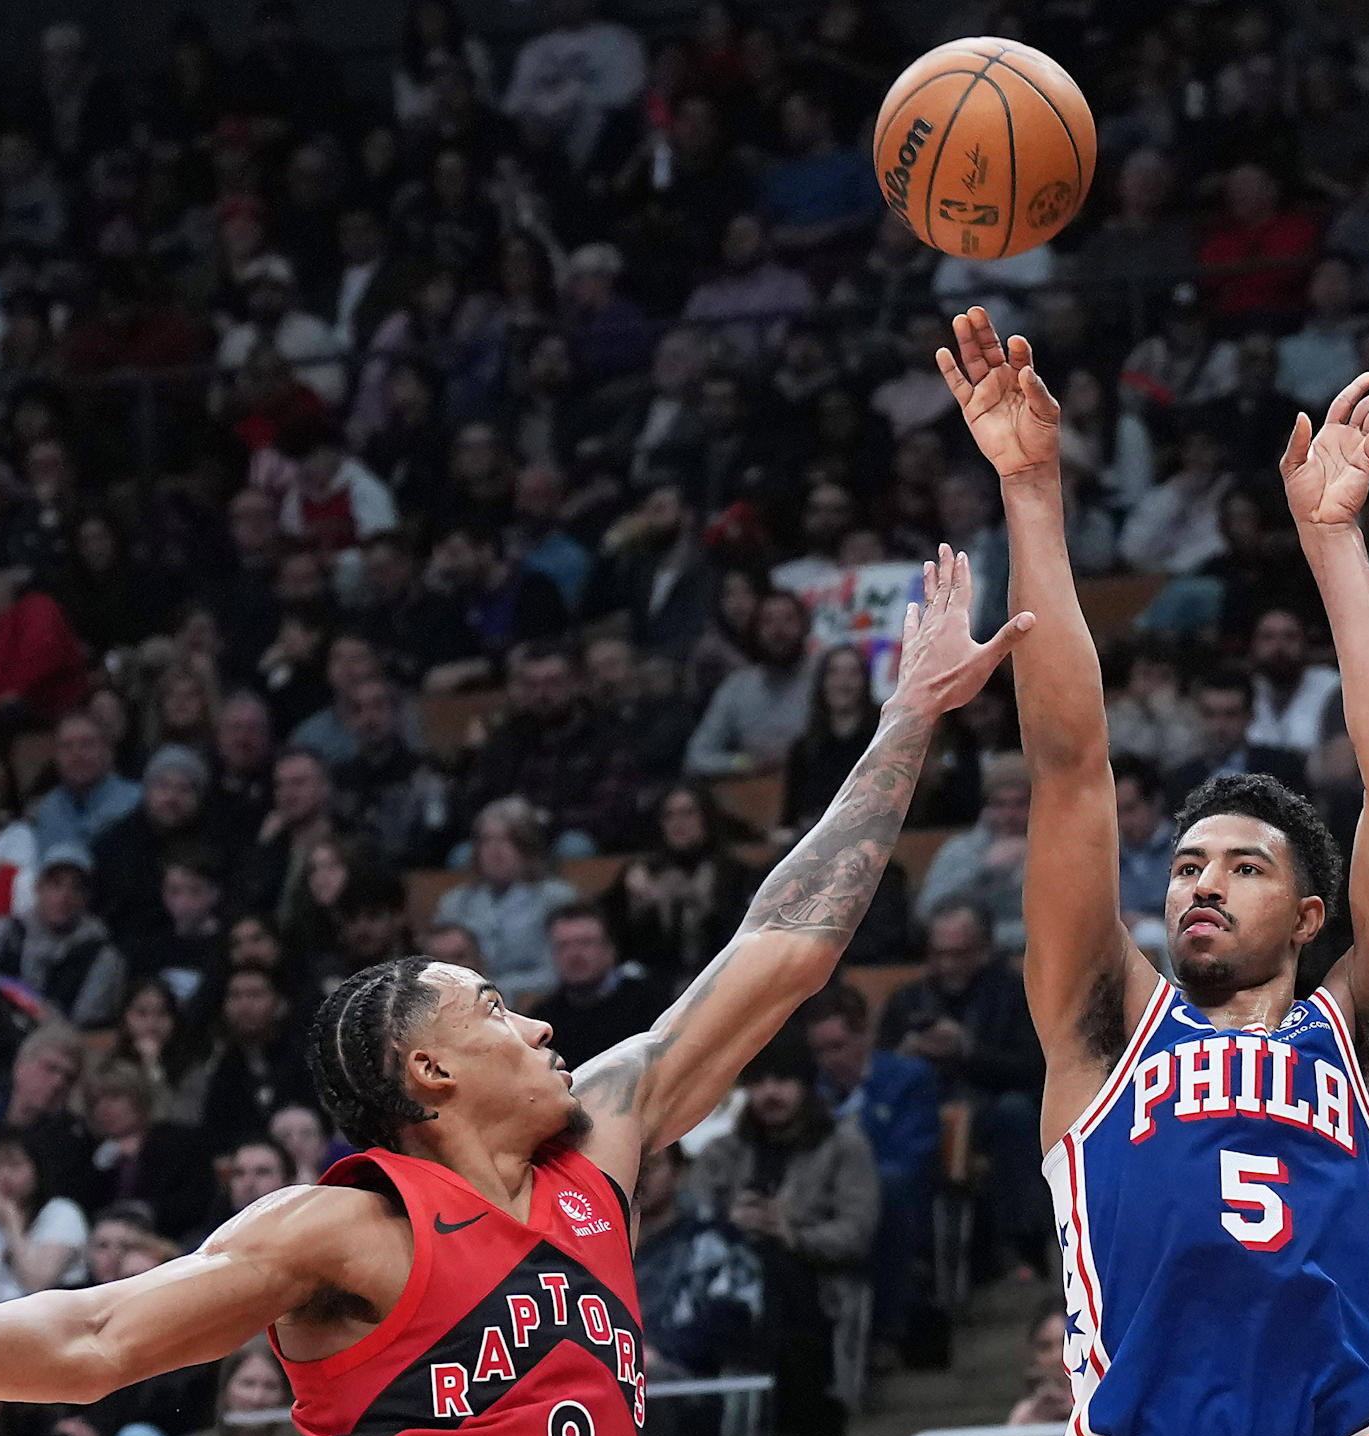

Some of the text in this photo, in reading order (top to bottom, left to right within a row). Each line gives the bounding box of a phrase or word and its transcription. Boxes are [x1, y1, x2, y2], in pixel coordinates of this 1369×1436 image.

[1277, 1020, 1331, 1042] rypto.com
[1130, 1036, 1358, 1157] PHILA
[588, 1218, 612, 1234] Life
[1220, 1149, 1293, 1252] 5
[431, 1273, 646, 1428] RAPTORS
